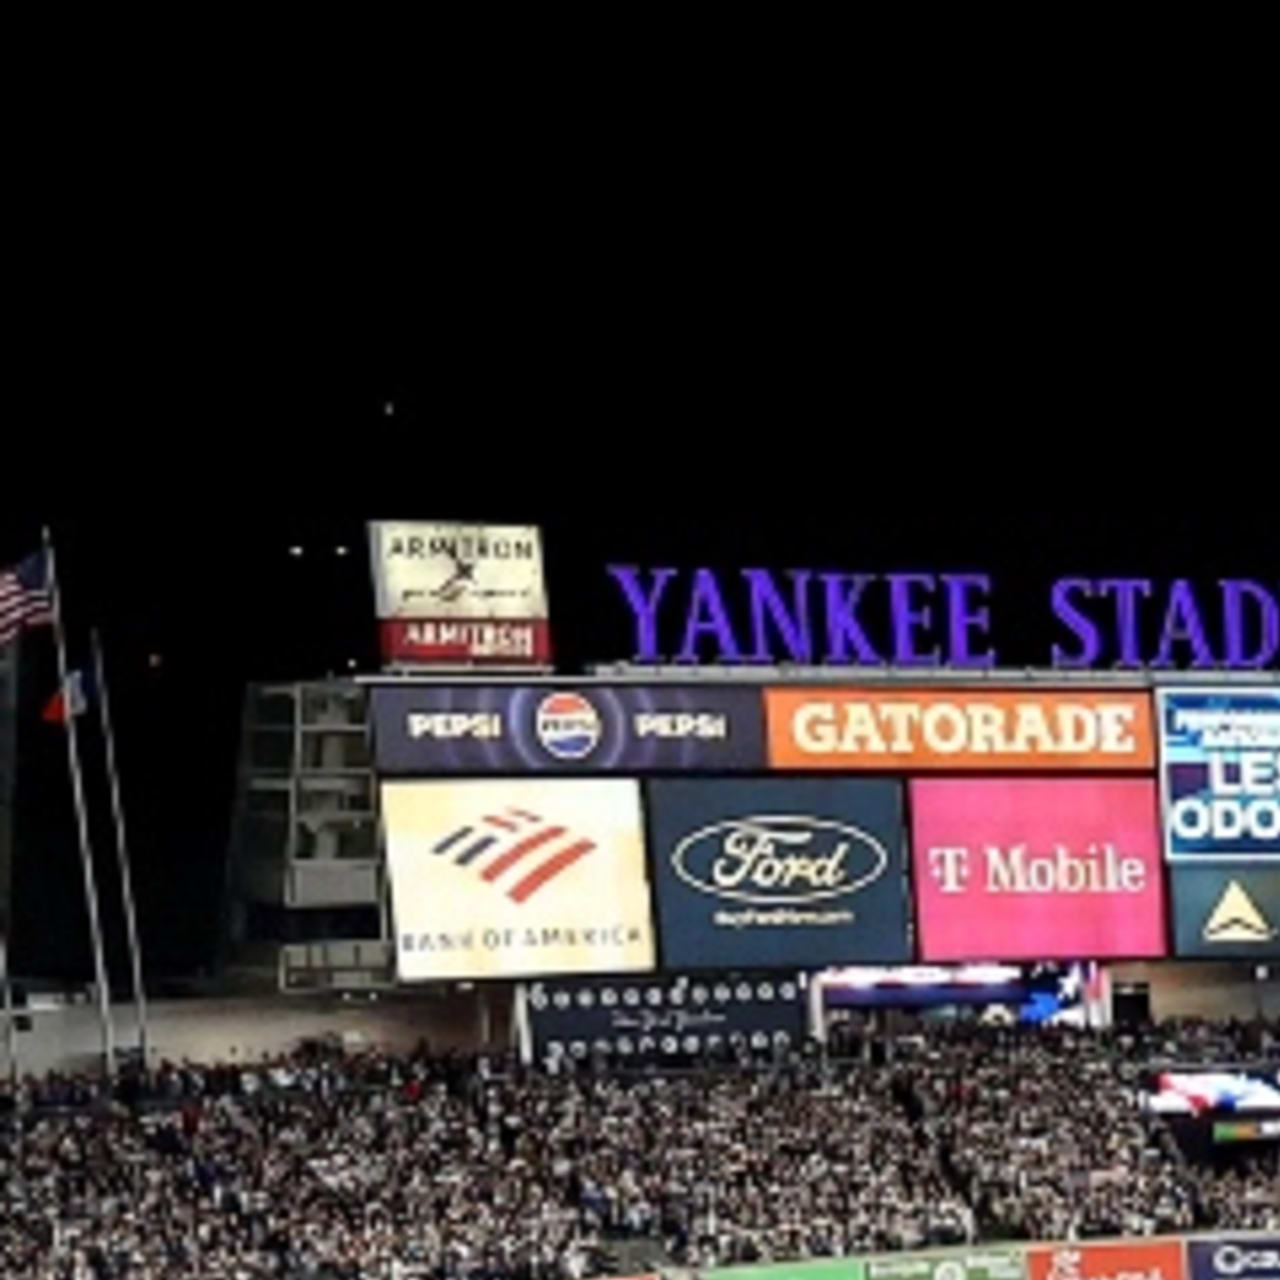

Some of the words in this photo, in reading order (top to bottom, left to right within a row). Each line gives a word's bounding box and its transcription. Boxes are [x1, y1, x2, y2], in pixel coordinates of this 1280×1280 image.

[606, 562, 995, 670] YANKEE
[407, 713, 501, 739] PEPSI
[633, 713, 727, 739] PEPSI
[791, 701, 1136, 754] GATORADE
[713, 825, 850, 887] Ford
[401, 932, 476, 952] BANK
[521, 926, 641, 948] AMERICA
